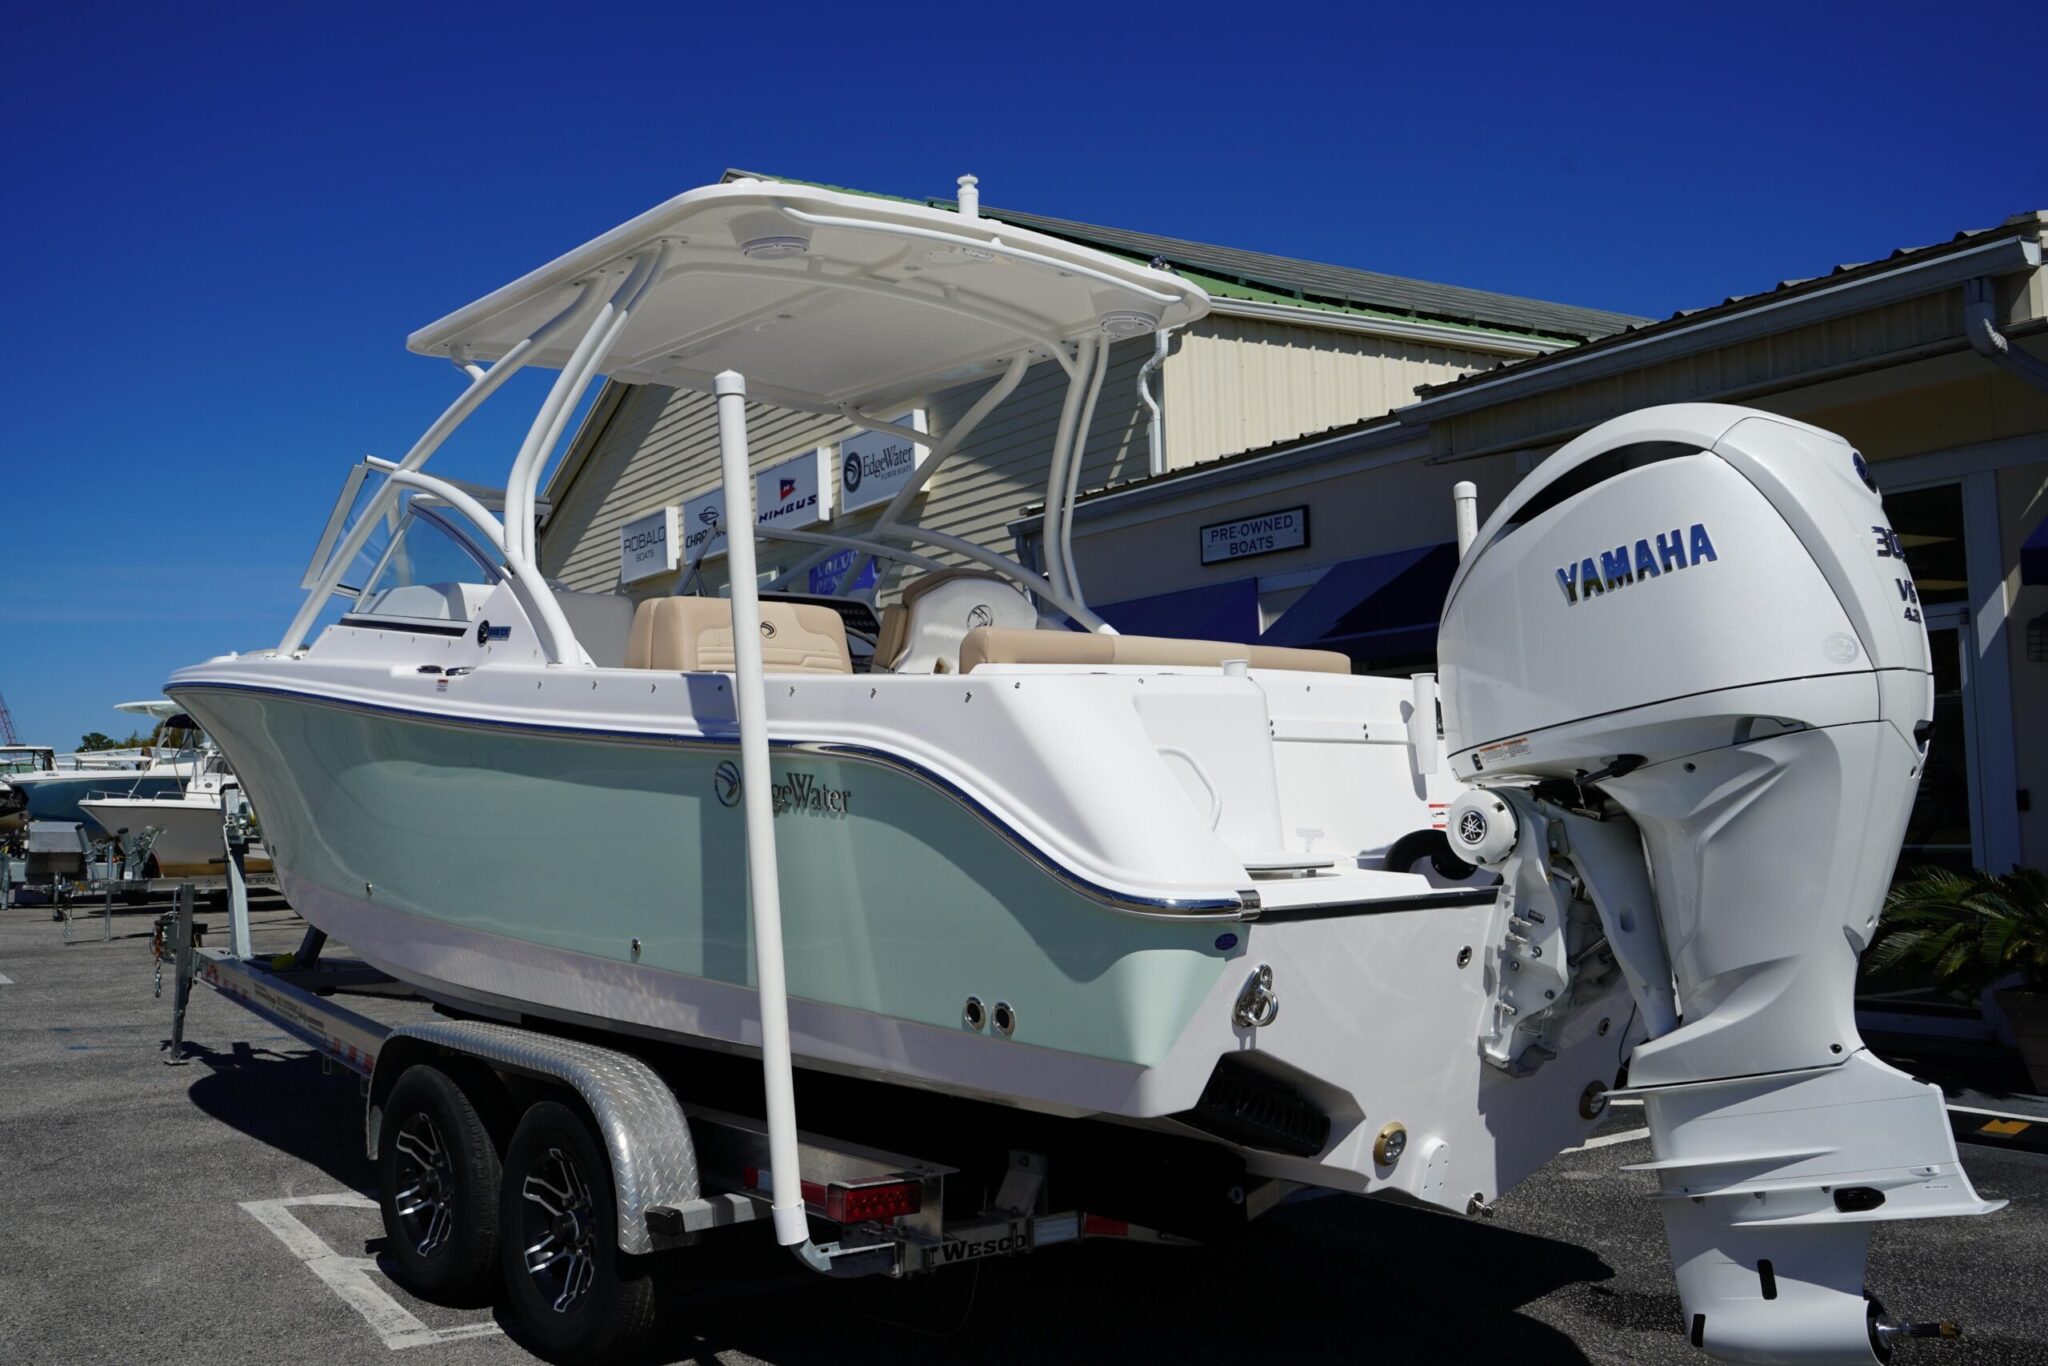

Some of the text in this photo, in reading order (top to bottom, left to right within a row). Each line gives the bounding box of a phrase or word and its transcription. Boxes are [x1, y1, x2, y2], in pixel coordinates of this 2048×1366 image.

[863, 445, 913, 478] EdgeWater
[758, 494, 817, 524] NIMBUS
[623, 525, 666, 554] ROBALO
[1211, 515, 1293, 542] PRE-OWNED
[636, 549, 655, 563] BOATS
[1230, 536, 1274, 555] BOATS
[1555, 523, 1718, 607] YAMAHA
[771, 772, 852, 814] geWater
